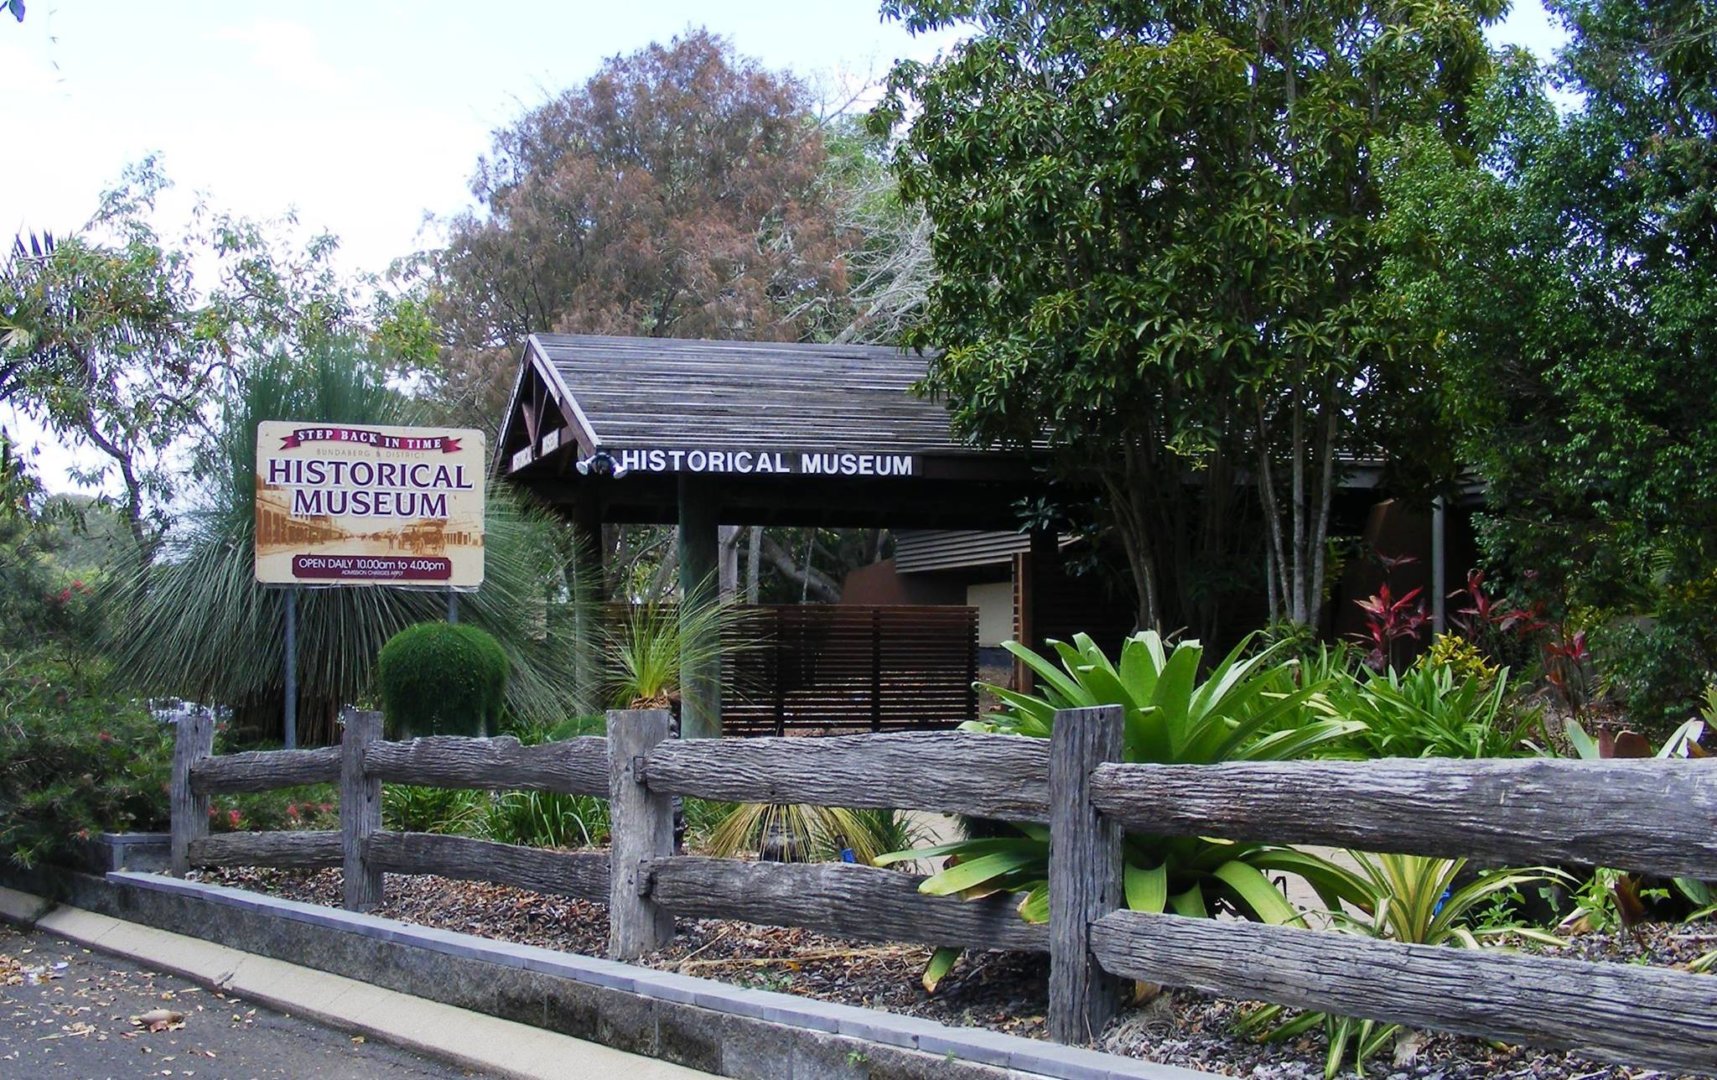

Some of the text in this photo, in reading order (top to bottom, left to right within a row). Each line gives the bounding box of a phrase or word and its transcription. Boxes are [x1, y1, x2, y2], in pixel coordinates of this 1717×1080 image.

[298, 430, 442, 449] STEP BACK IN TIME
[316, 448, 371, 457] BUNDABERG
[386, 451, 425, 459] DISTRICT
[621, 449, 913, 476] HISTORICAL MUSEUM
[268, 459, 473, 489] HISTORICAL
[293, 489, 448, 517] MUSEUM
[298, 558, 445, 571] OPEN DAILY 10.00am to 4.00pm
